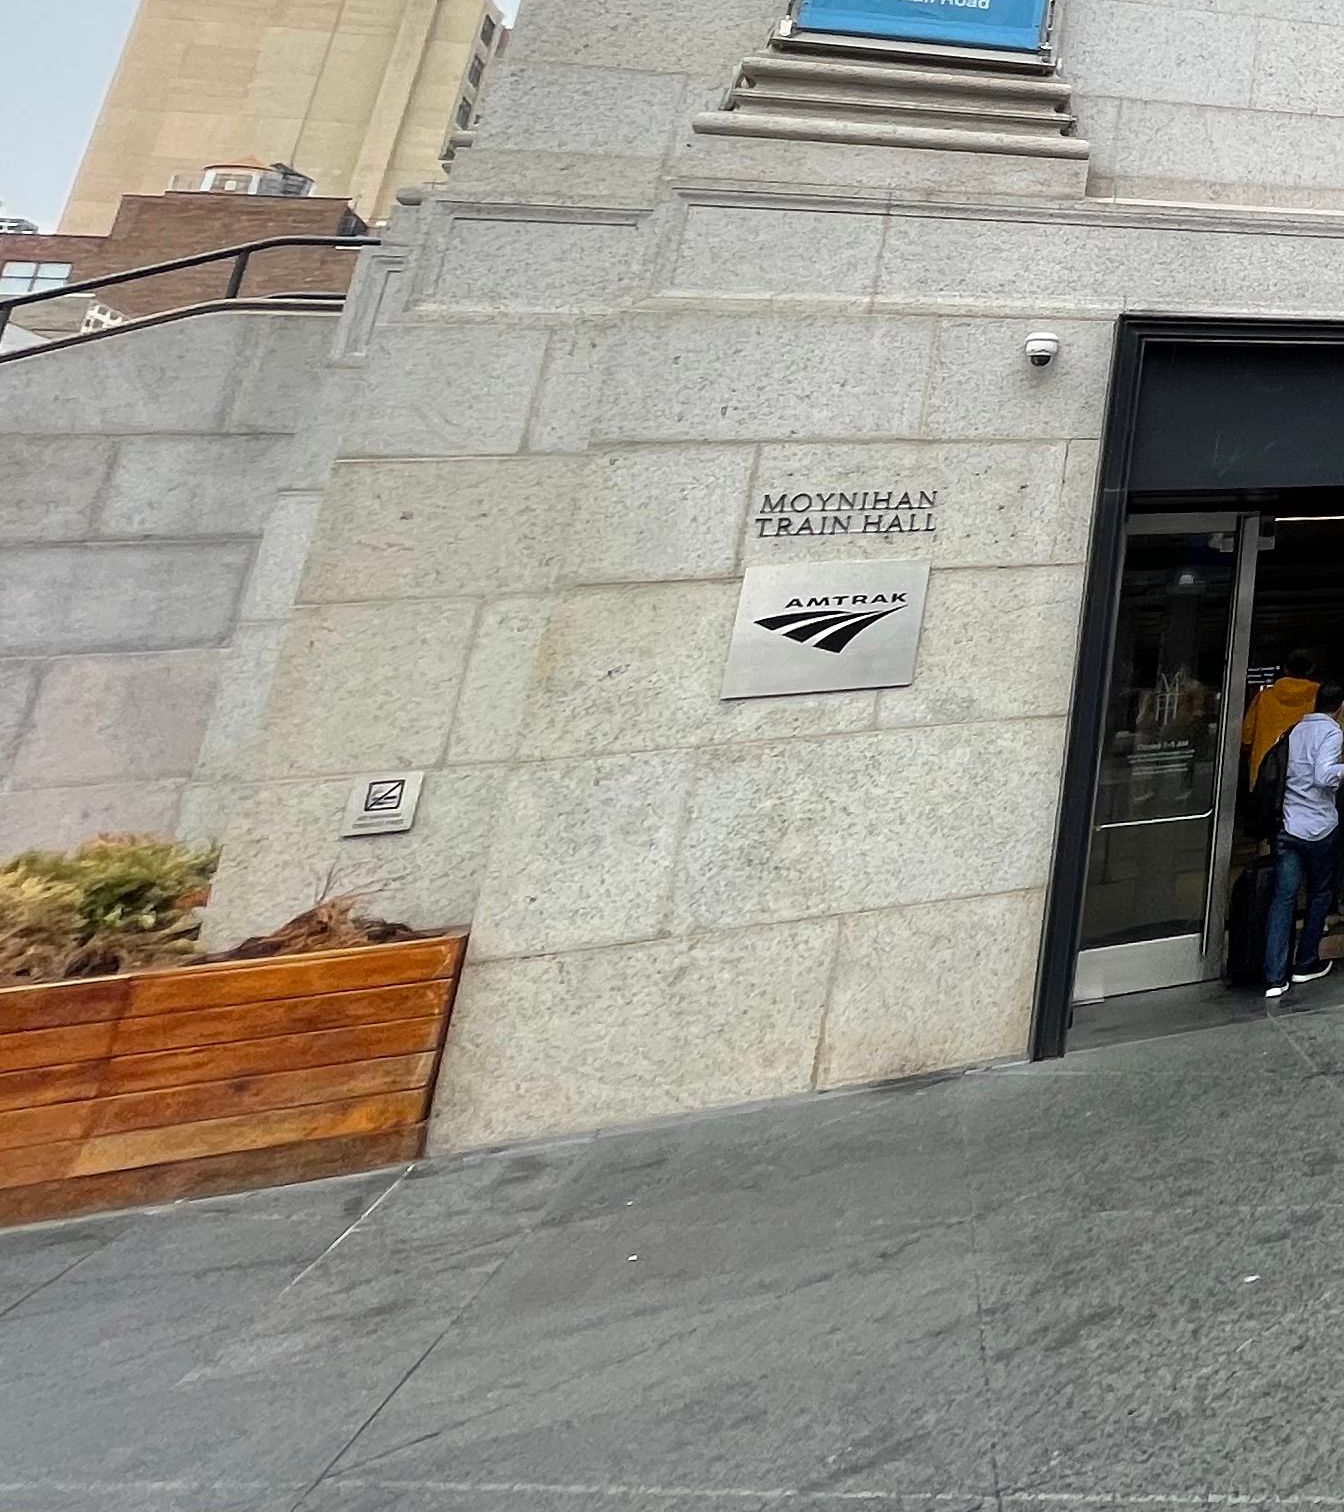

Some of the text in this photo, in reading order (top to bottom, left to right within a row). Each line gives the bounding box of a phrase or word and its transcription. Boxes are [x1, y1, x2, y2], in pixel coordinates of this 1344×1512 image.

[759, 490, 938, 514] MOYNIHAN
[755, 513, 938, 538] TRAIN HALL
[785, 592, 907, 608] AMTRAK
